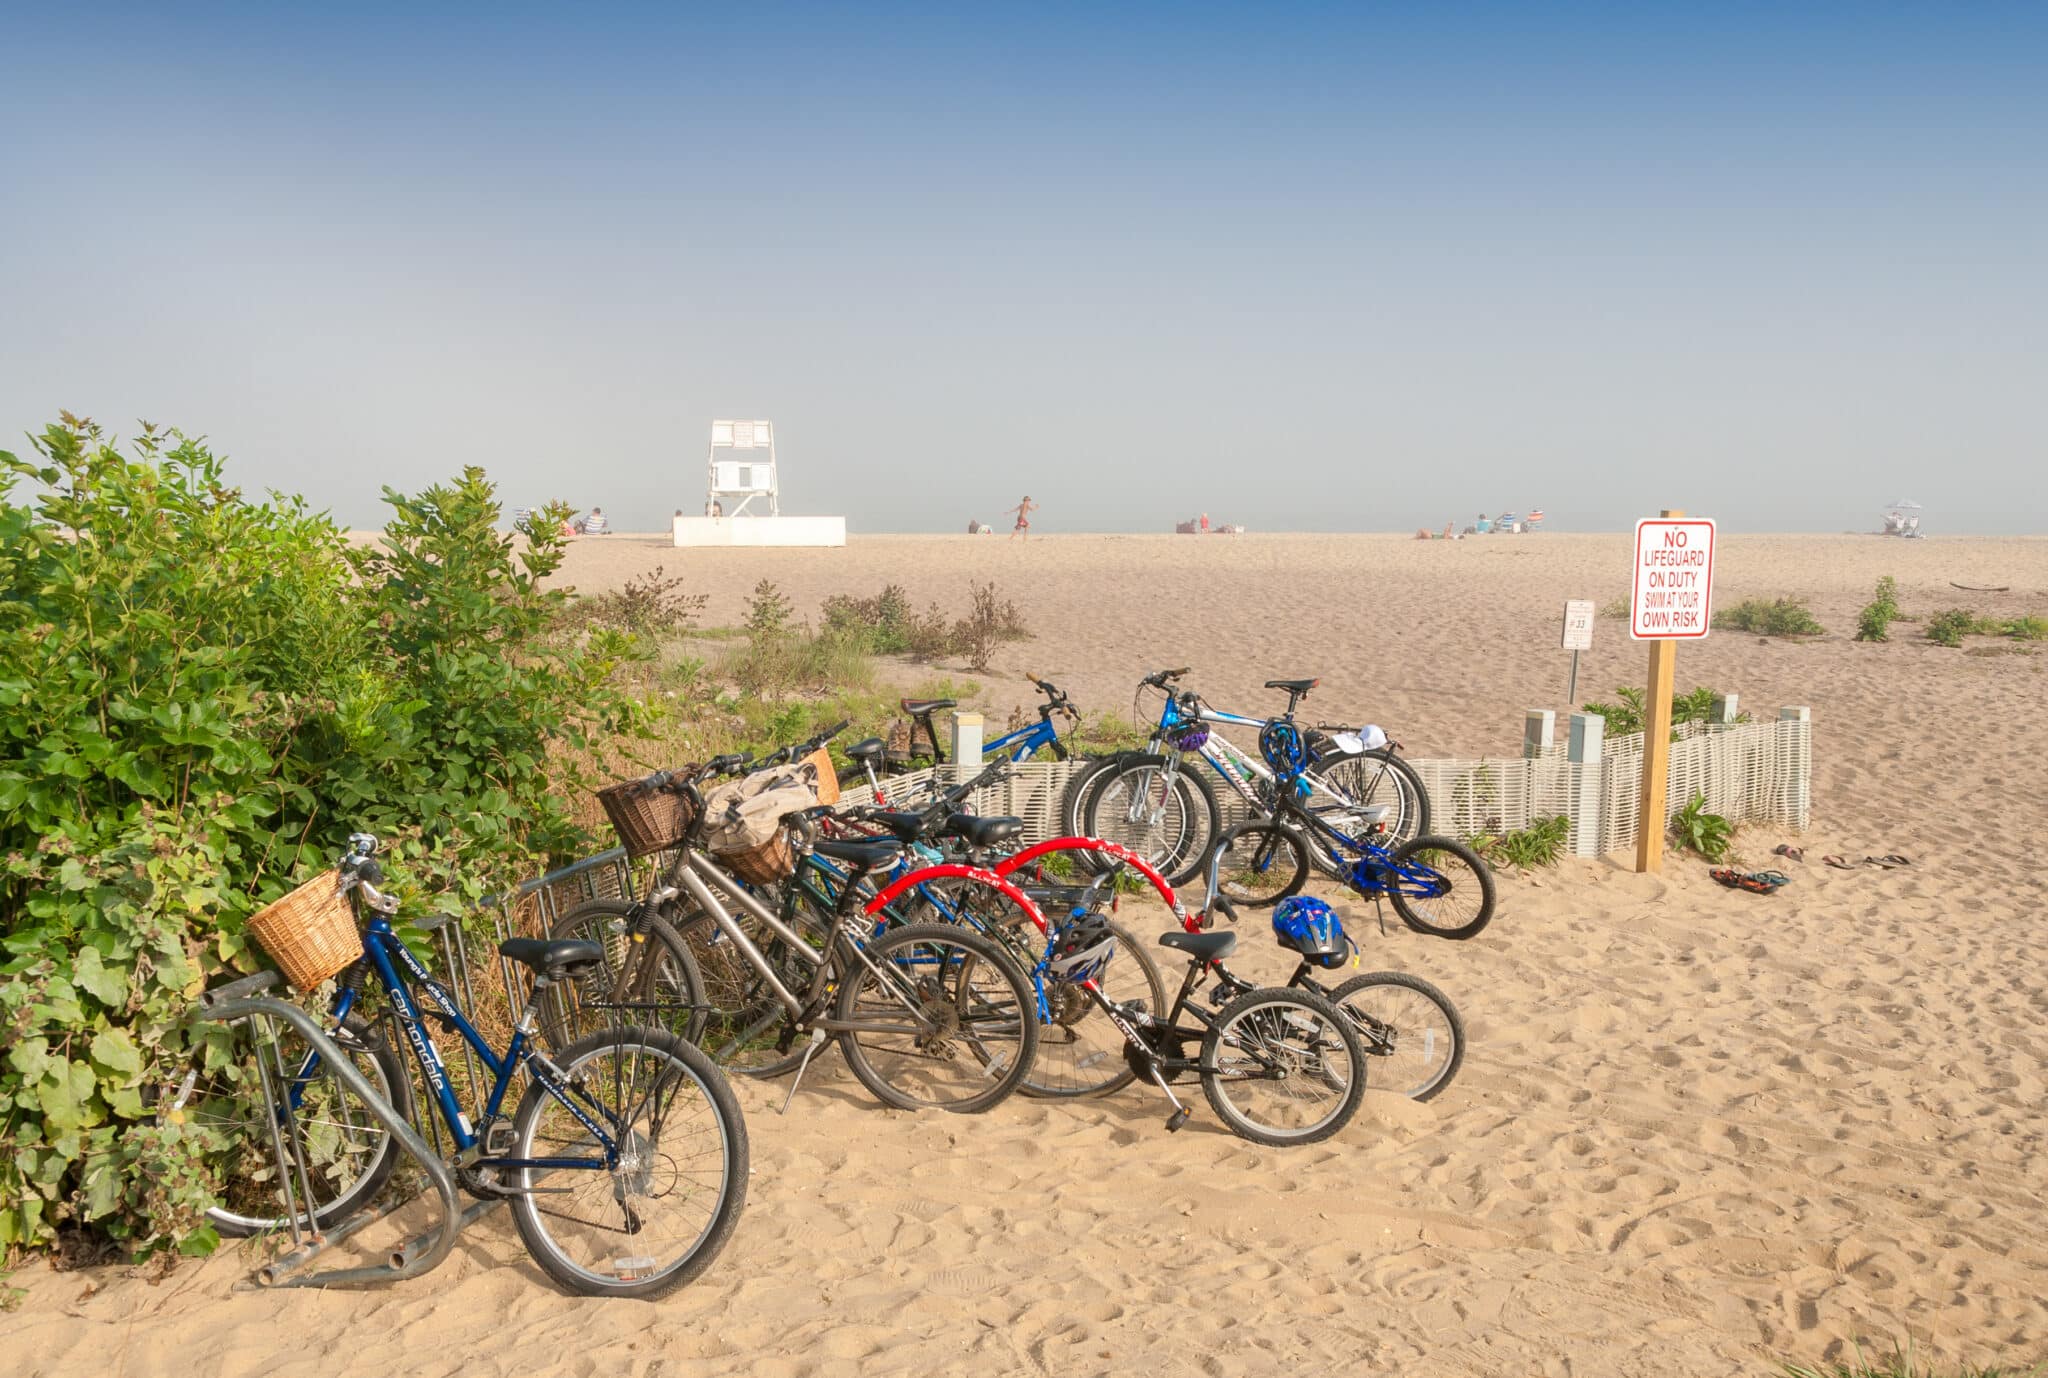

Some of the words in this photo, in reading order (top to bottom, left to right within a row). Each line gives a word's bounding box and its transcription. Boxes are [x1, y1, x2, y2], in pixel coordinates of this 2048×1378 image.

[1665, 531, 1687, 547] NO
[1644, 550, 1704, 566] LIFEGUARD
[1649, 571, 1665, 587] ON
[1668, 571, 1698, 587] DUTY
[1645, 592, 1665, 608] SWIM
[1666, 592, 1676, 607] AT
[1677, 592, 1699, 608] YOUR
[1643, 611, 1669, 627] OWN
[1672, 611, 1698, 627] RISK
[400, 948, 422, 976] Young's
[439, 996, 457, 1017] Shop
